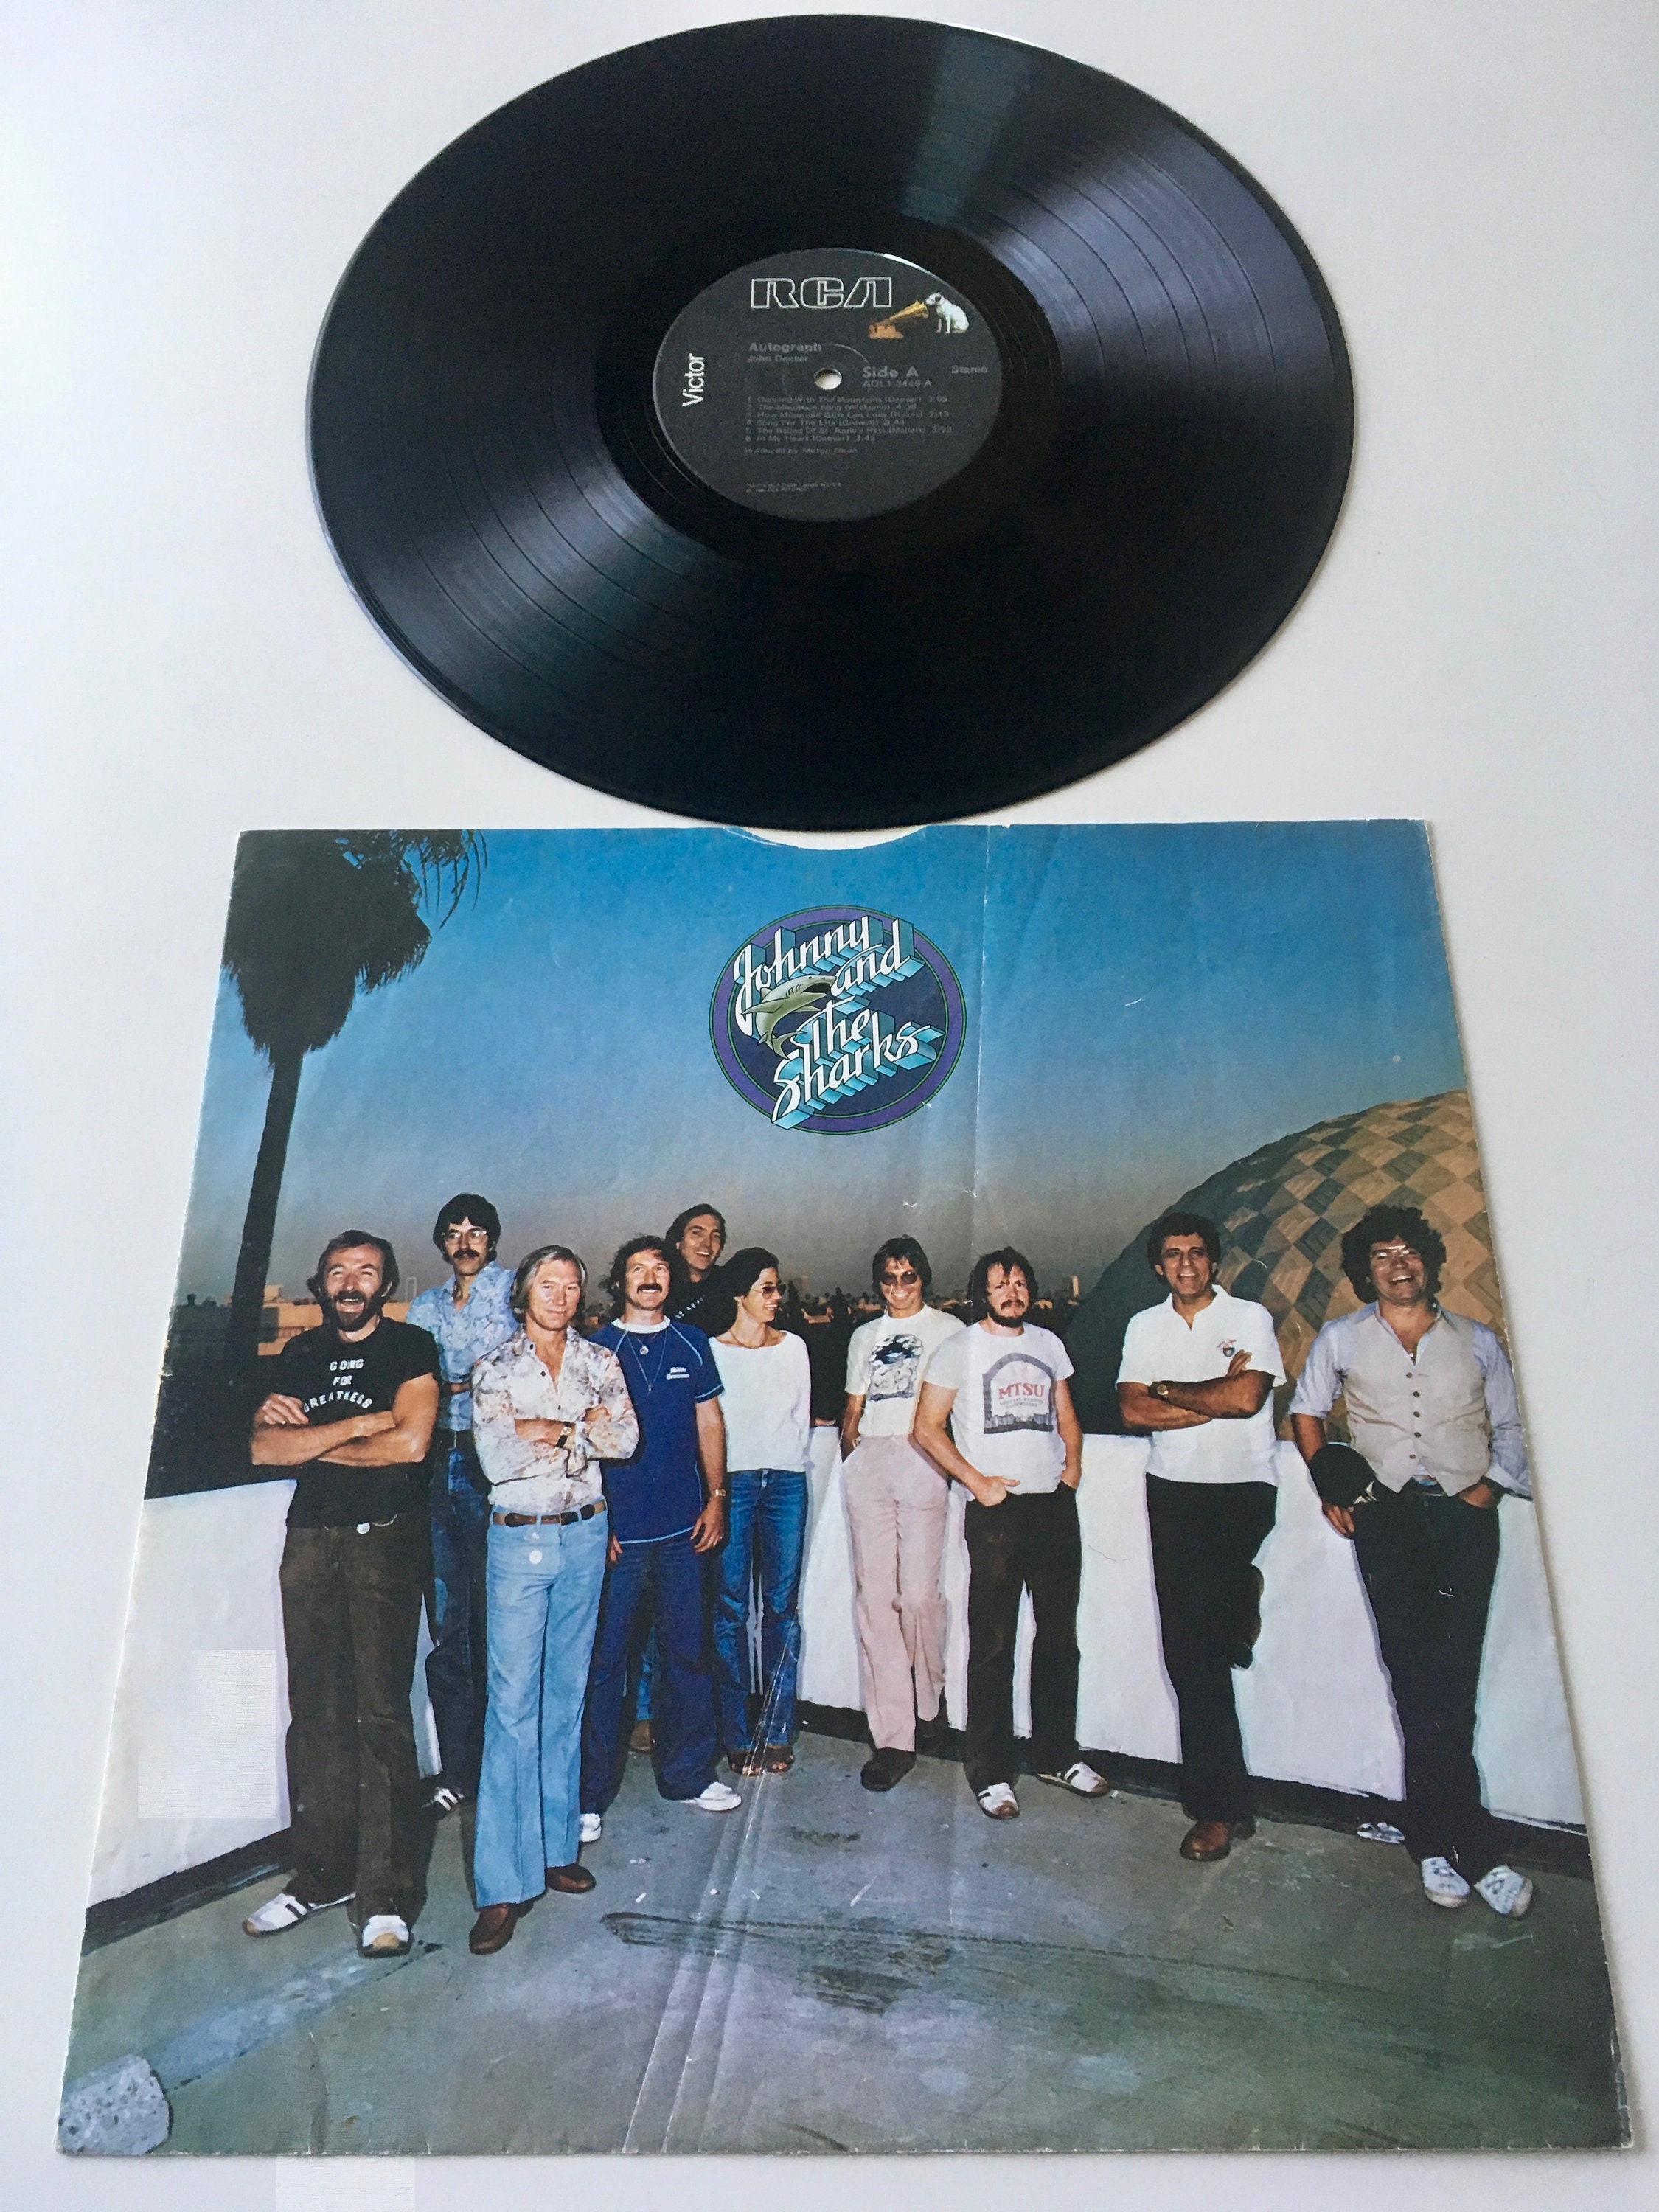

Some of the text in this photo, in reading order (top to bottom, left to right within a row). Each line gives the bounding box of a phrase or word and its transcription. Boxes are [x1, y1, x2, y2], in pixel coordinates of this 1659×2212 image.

[751, 276, 892, 308] RCA
[749, 342, 822, 354] Autograph
[747, 355, 772, 363] John
[862, 365, 919, 378] Side A
[951, 365, 989, 375] Stereo
[682, 352, 705, 407] Victor
[830, 918, 925, 1001] and
[733, 915, 884, 1040] Johnny
[790, 995, 872, 1068] The
[771, 1010, 945, 1130] Sharks
[329, 1358, 364, 1371] GOING
[332, 1374, 352, 1386] FOR
[998, 1382, 1045, 1399] MTSU
